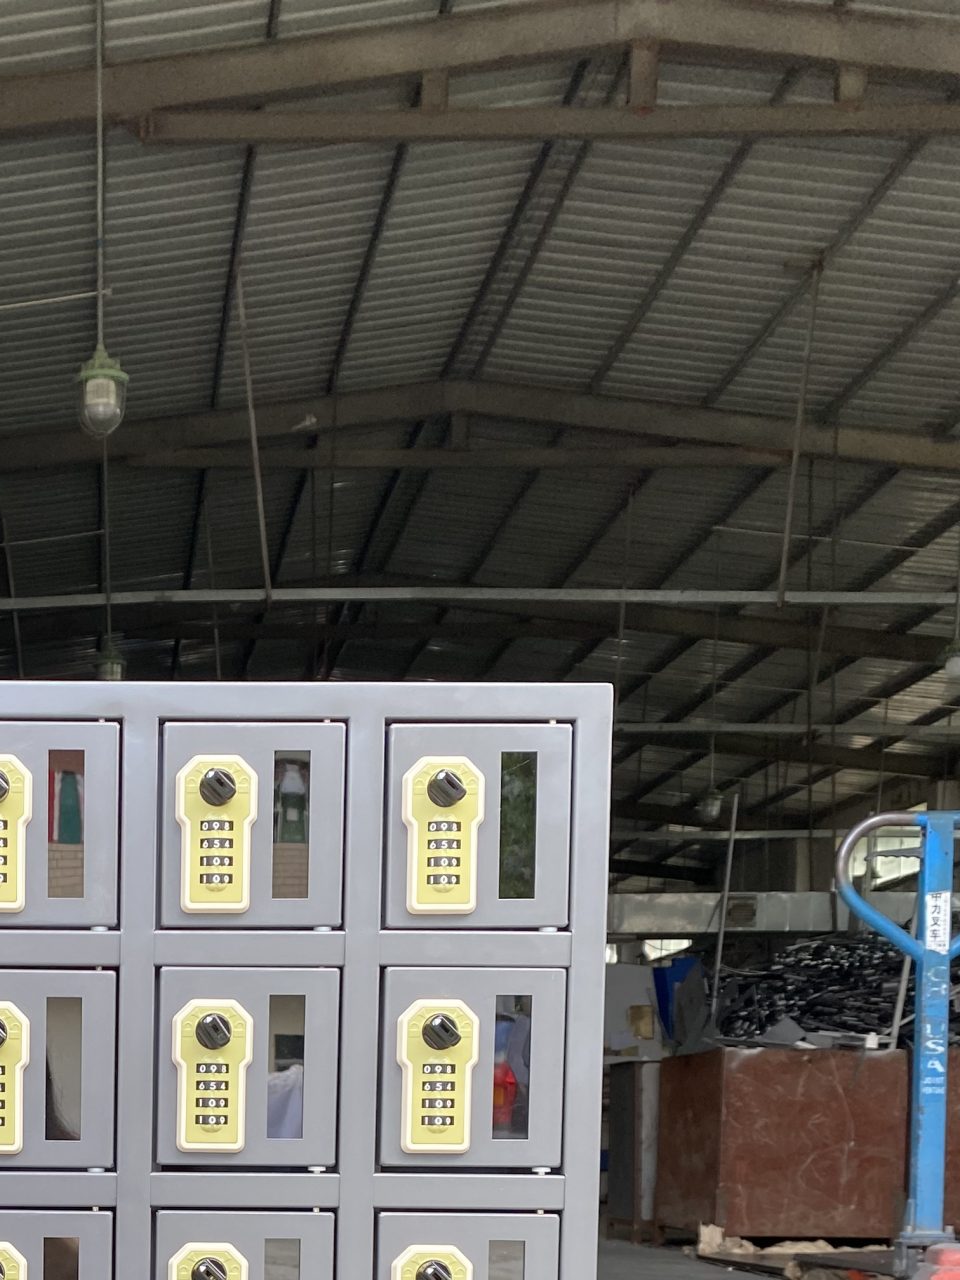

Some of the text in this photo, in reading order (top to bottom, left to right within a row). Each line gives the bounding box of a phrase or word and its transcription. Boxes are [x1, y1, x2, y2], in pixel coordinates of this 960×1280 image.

[201, 820, 230, 831] 098
[202, 840, 230, 848] 654
[203, 857, 230, 866] 109
[203, 875, 230, 883] 109
[199, 1063, 227, 1073] 098
[199, 1082, 226, 1090] 654
[199, 1099, 226, 1108] 109
[199, 1116, 226, 1125] 109
